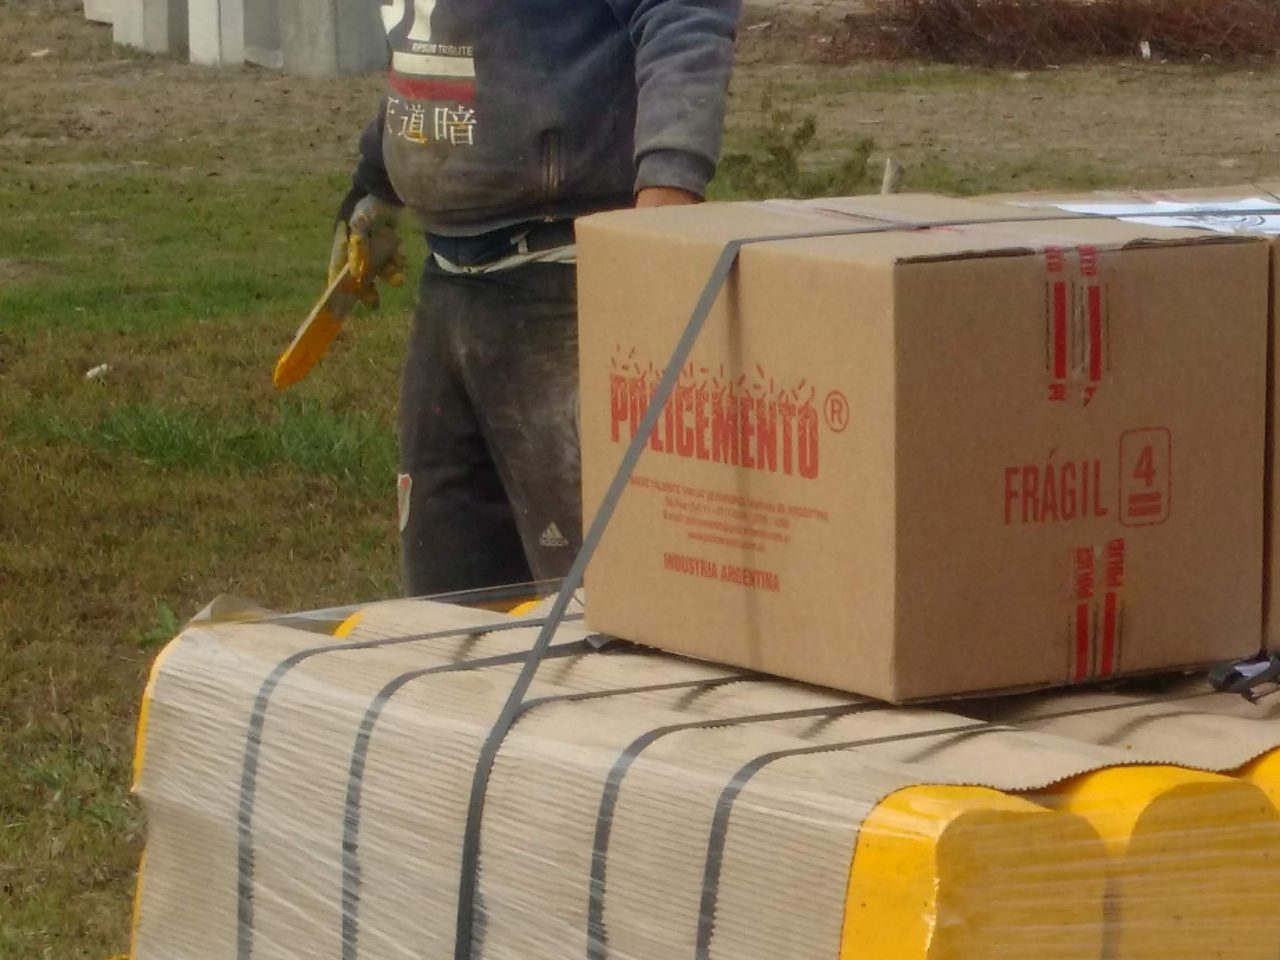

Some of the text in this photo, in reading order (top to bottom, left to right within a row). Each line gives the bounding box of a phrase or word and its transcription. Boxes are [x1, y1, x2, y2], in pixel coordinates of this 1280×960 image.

[1004, 448, 1108, 526] FRÁGIL
[1132, 445, 1156, 488] 4
[663, 552, 781, 592] INDUSTRIA ARGENTINA
